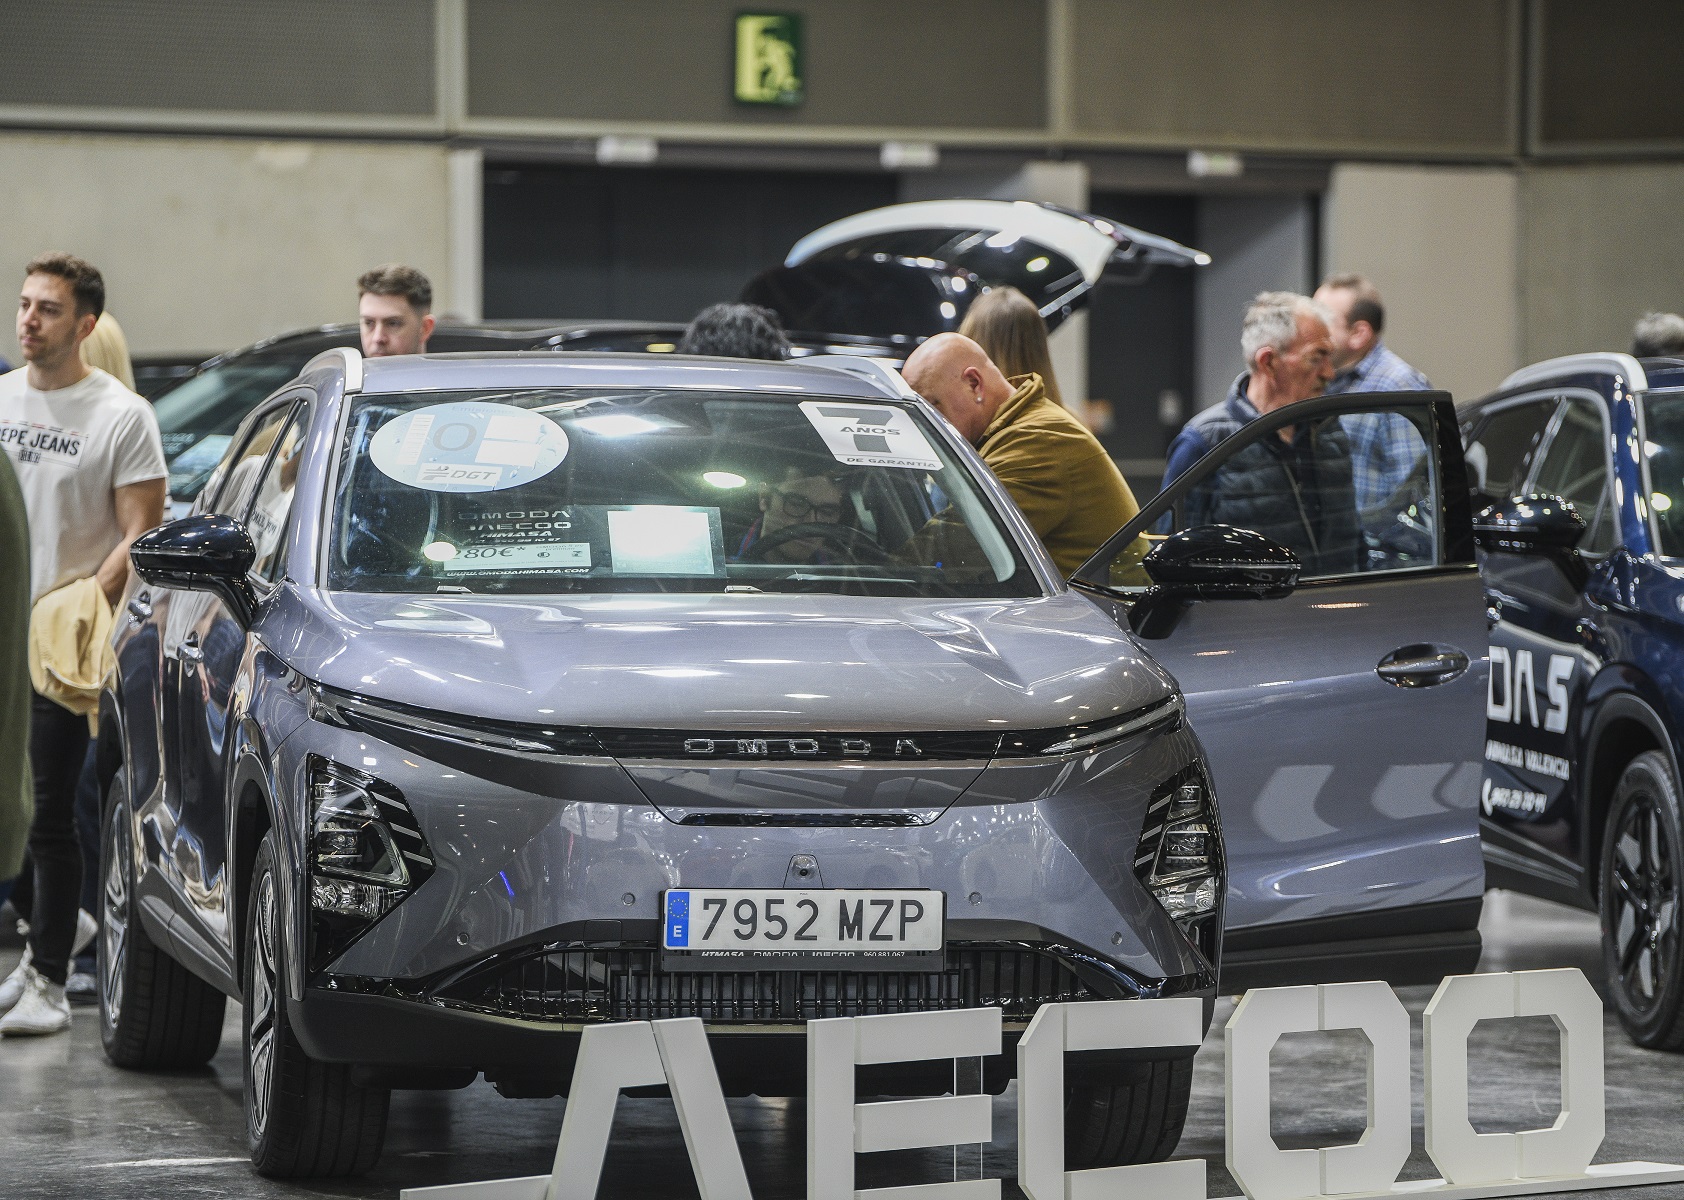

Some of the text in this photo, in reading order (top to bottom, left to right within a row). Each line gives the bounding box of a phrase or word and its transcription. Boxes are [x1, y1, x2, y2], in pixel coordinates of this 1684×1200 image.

[840, 425, 900, 435] AÑOS
[0, 428, 80, 456] EPE JEANS
[451, 470, 497, 481] DGT
[459, 511, 570, 520] OMODA
[684, 738, 923, 756] OMODA
[673, 898, 924, 942] E 7952 MZP
[400, 970, 1605, 1200] AECOO
